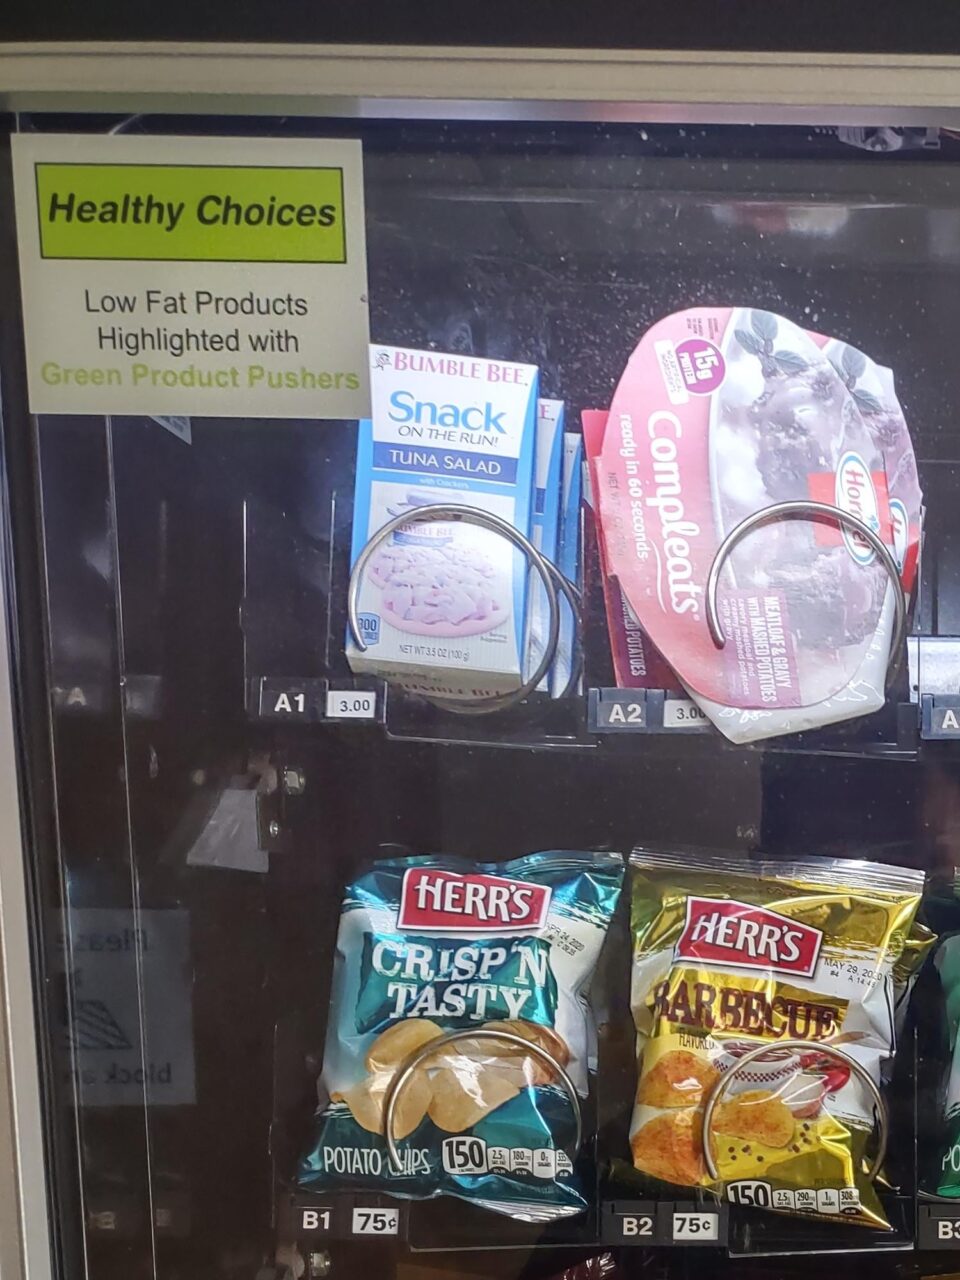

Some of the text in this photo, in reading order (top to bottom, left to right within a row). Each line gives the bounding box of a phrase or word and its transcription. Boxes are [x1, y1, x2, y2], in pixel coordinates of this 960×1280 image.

[49, 193, 336, 231] Healthy Choices
[85, 289, 308, 316] Low Fat Products
[99, 326, 299, 357] Highlighted with
[41, 361, 360, 390] Green Product Pushers
[394, 351, 481, 380] BUMBLE
[694, 346, 718, 380] 15g
[388, 390, 507, 434] Snack
[398, 425, 499, 447] ON THE RUN!
[389, 449, 501, 475] TUNA SALAD
[619, 414, 649, 562] ready in 60 seconds
[647, 410, 699, 616] Compleats
[764, 596, 792, 689] MEATLOAF GRAVY
[751, 617, 777, 702] MASHED POTATOES
[274, 693, 305, 712] A1
[340, 700, 370, 713] 3.00
[608, 703, 642, 723] A2
[414, 875, 532, 922] HERR'S
[691, 912, 803, 963] HERR'S
[372, 942, 507, 983] CRISP
[387, 982, 533, 1022] TASTY
[654, 981, 837, 1040] BARBECUE
[323, 1146, 382, 1175] POTATO
[445, 1140, 484, 1170] 150
[303, 1210, 330, 1229] B1
[357, 1212, 397, 1232] 75¢
[622, 1217, 653, 1235] B2
[675, 1218, 711, 1234] 75¢
